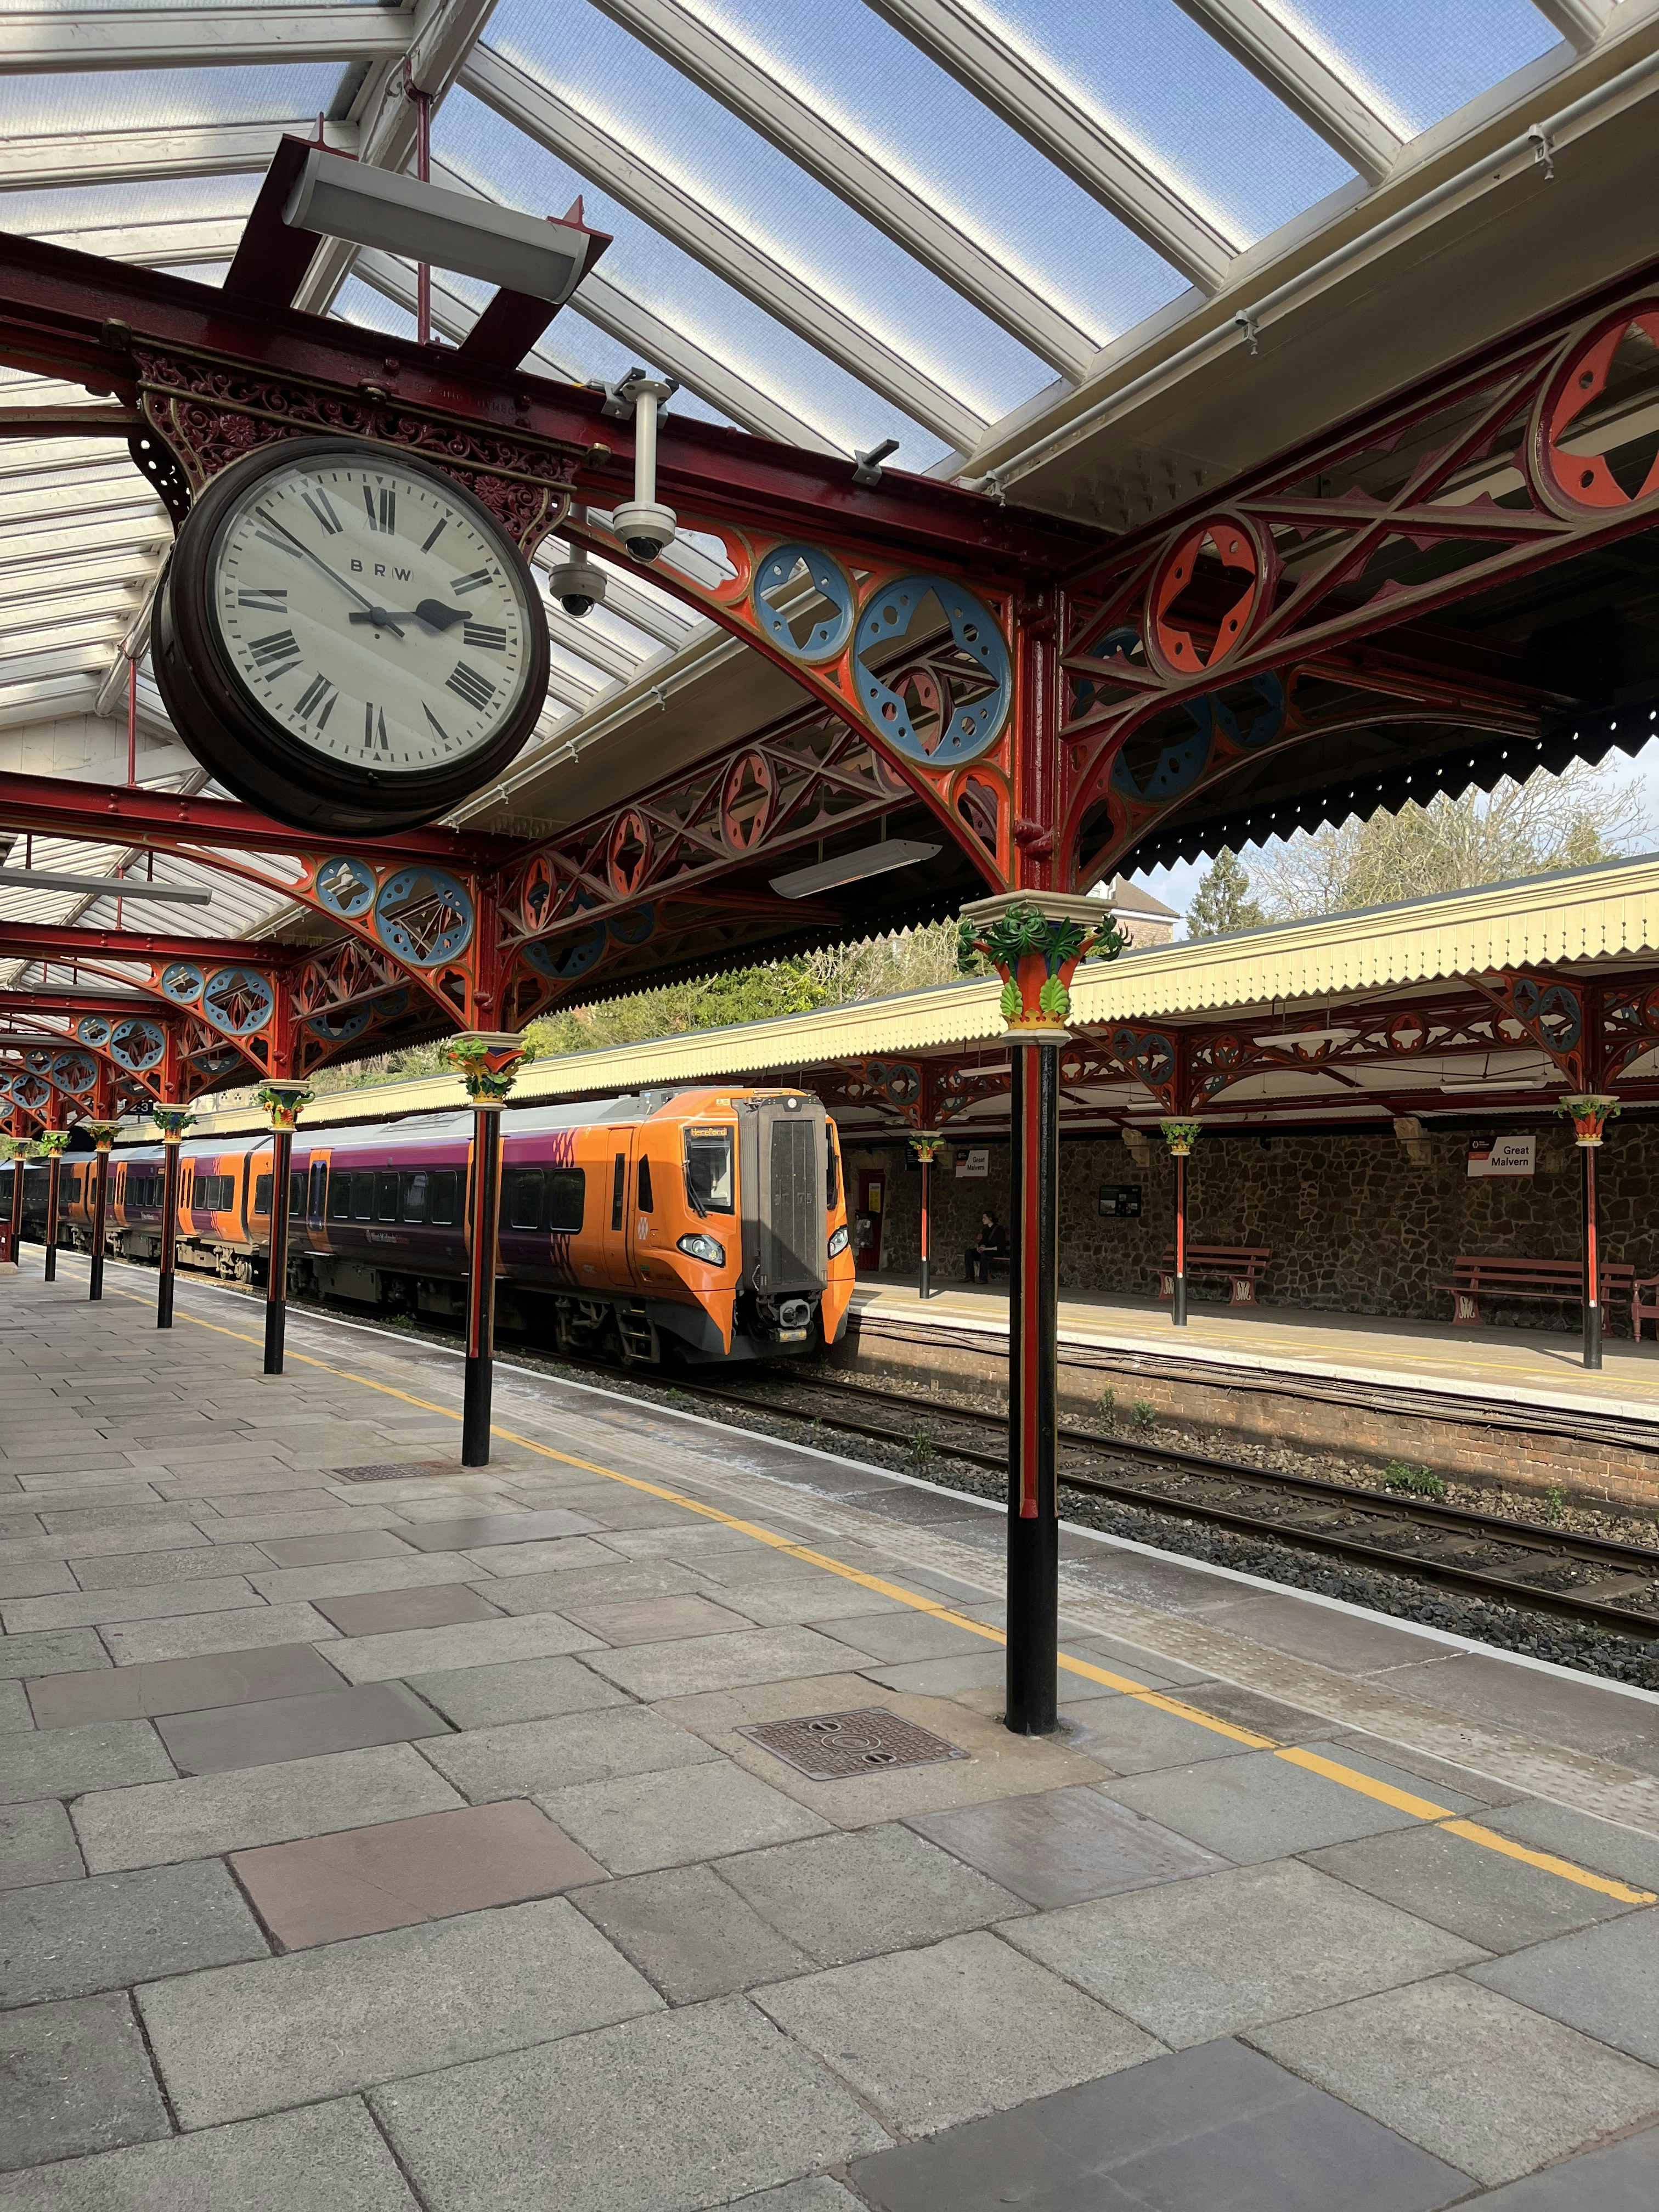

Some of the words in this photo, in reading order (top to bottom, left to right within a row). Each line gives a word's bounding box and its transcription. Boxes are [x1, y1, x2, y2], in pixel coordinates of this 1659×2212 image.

[301, 487, 344, 538] XI
[363, 486, 396, 535] XII
[247, 627, 304, 683] VIII
[463, 621, 506, 651] III
[293, 670, 340, 730] VII
[691, 1127, 727, 1137] Hereford
[1504, 1146, 1530, 1155] Great
[1492, 1157, 1528, 1166] Malvern
